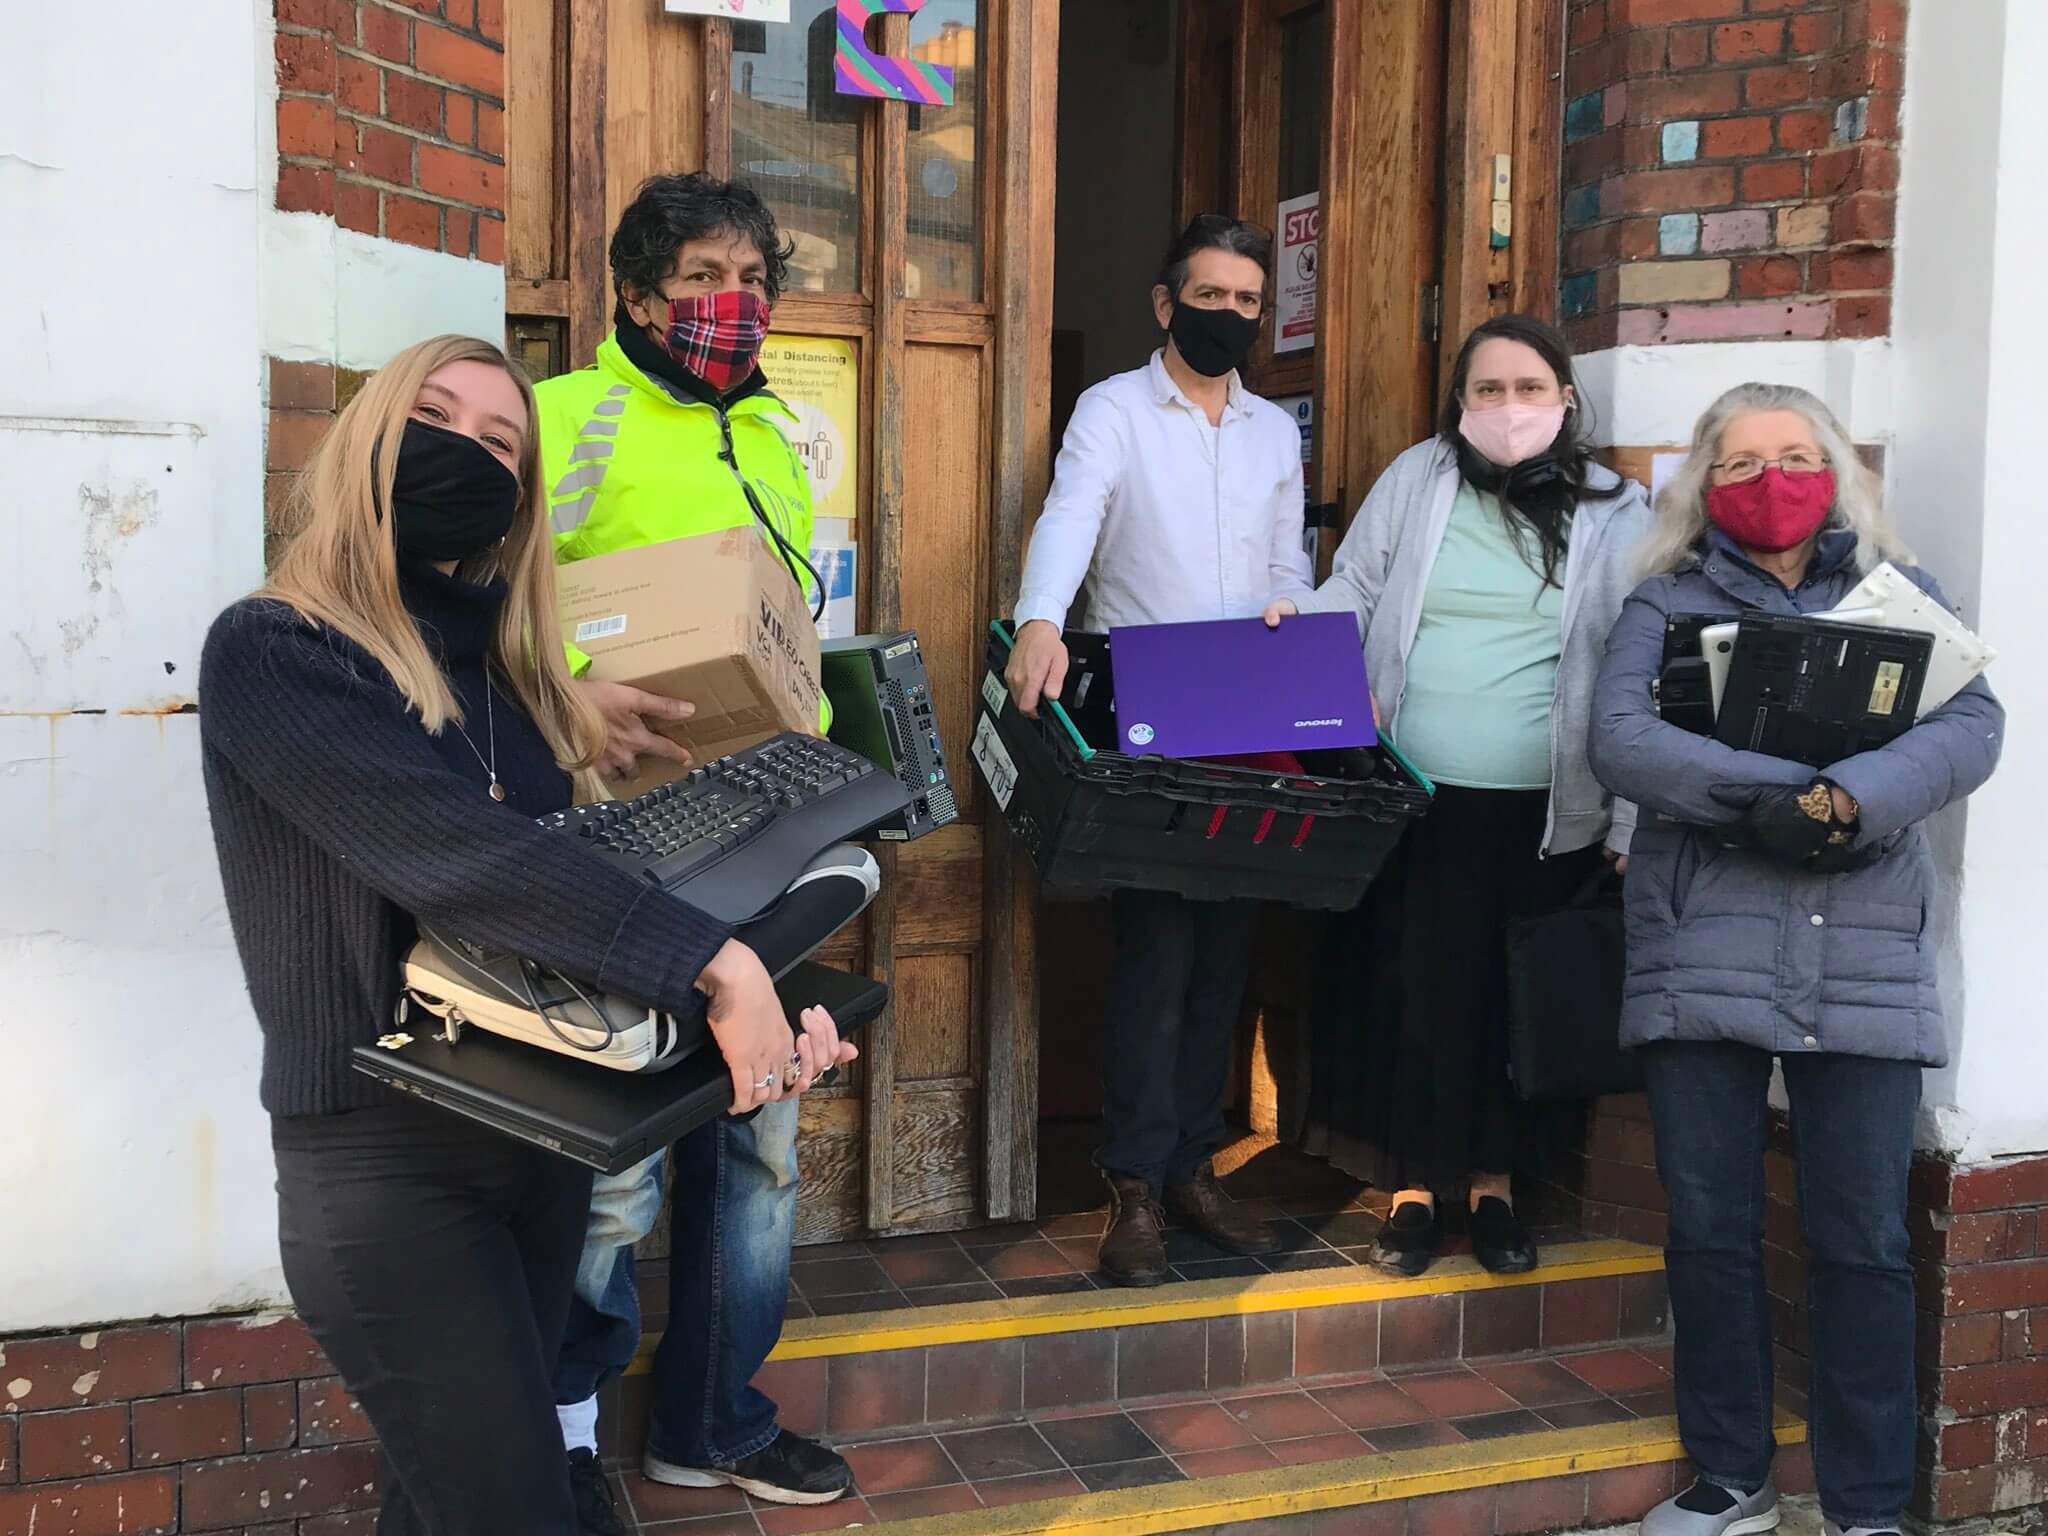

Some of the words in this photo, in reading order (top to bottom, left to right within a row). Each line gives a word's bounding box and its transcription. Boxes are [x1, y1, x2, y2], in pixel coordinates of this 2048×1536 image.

[1286, 210, 1320, 243] STO
[758, 350, 778, 360] cial
[784, 350, 847, 366] Distancing
[768, 376, 793, 386] etres
[791, 441, 810, 456] m
[760, 599, 799, 665] VIDEO
[1293, 718, 1343, 728] lenovo
